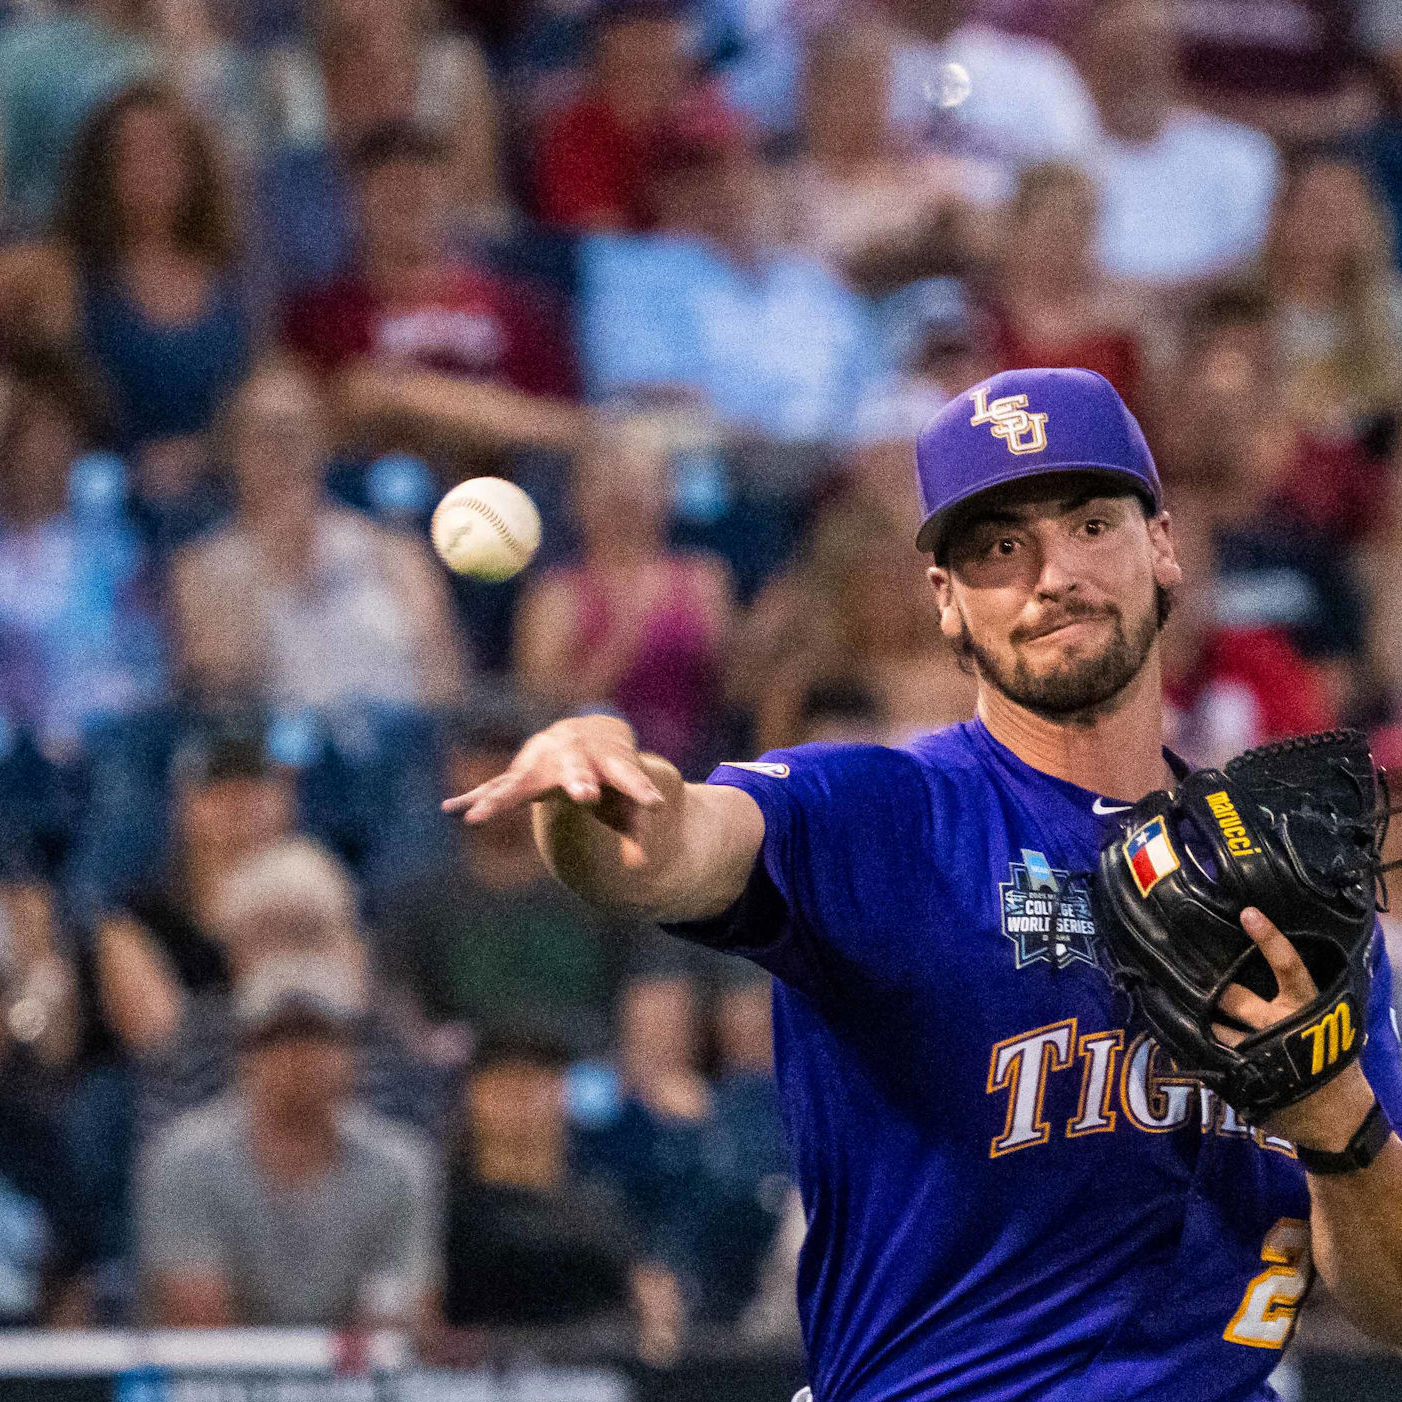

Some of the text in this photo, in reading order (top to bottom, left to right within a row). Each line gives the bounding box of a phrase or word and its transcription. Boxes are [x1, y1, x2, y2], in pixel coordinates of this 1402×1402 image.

[969, 386, 1049, 455] LSU
[1205, 790, 1262, 856] marucci
[1056, 918, 1095, 935] SERIES
[986, 1017, 1298, 1159] TIG
